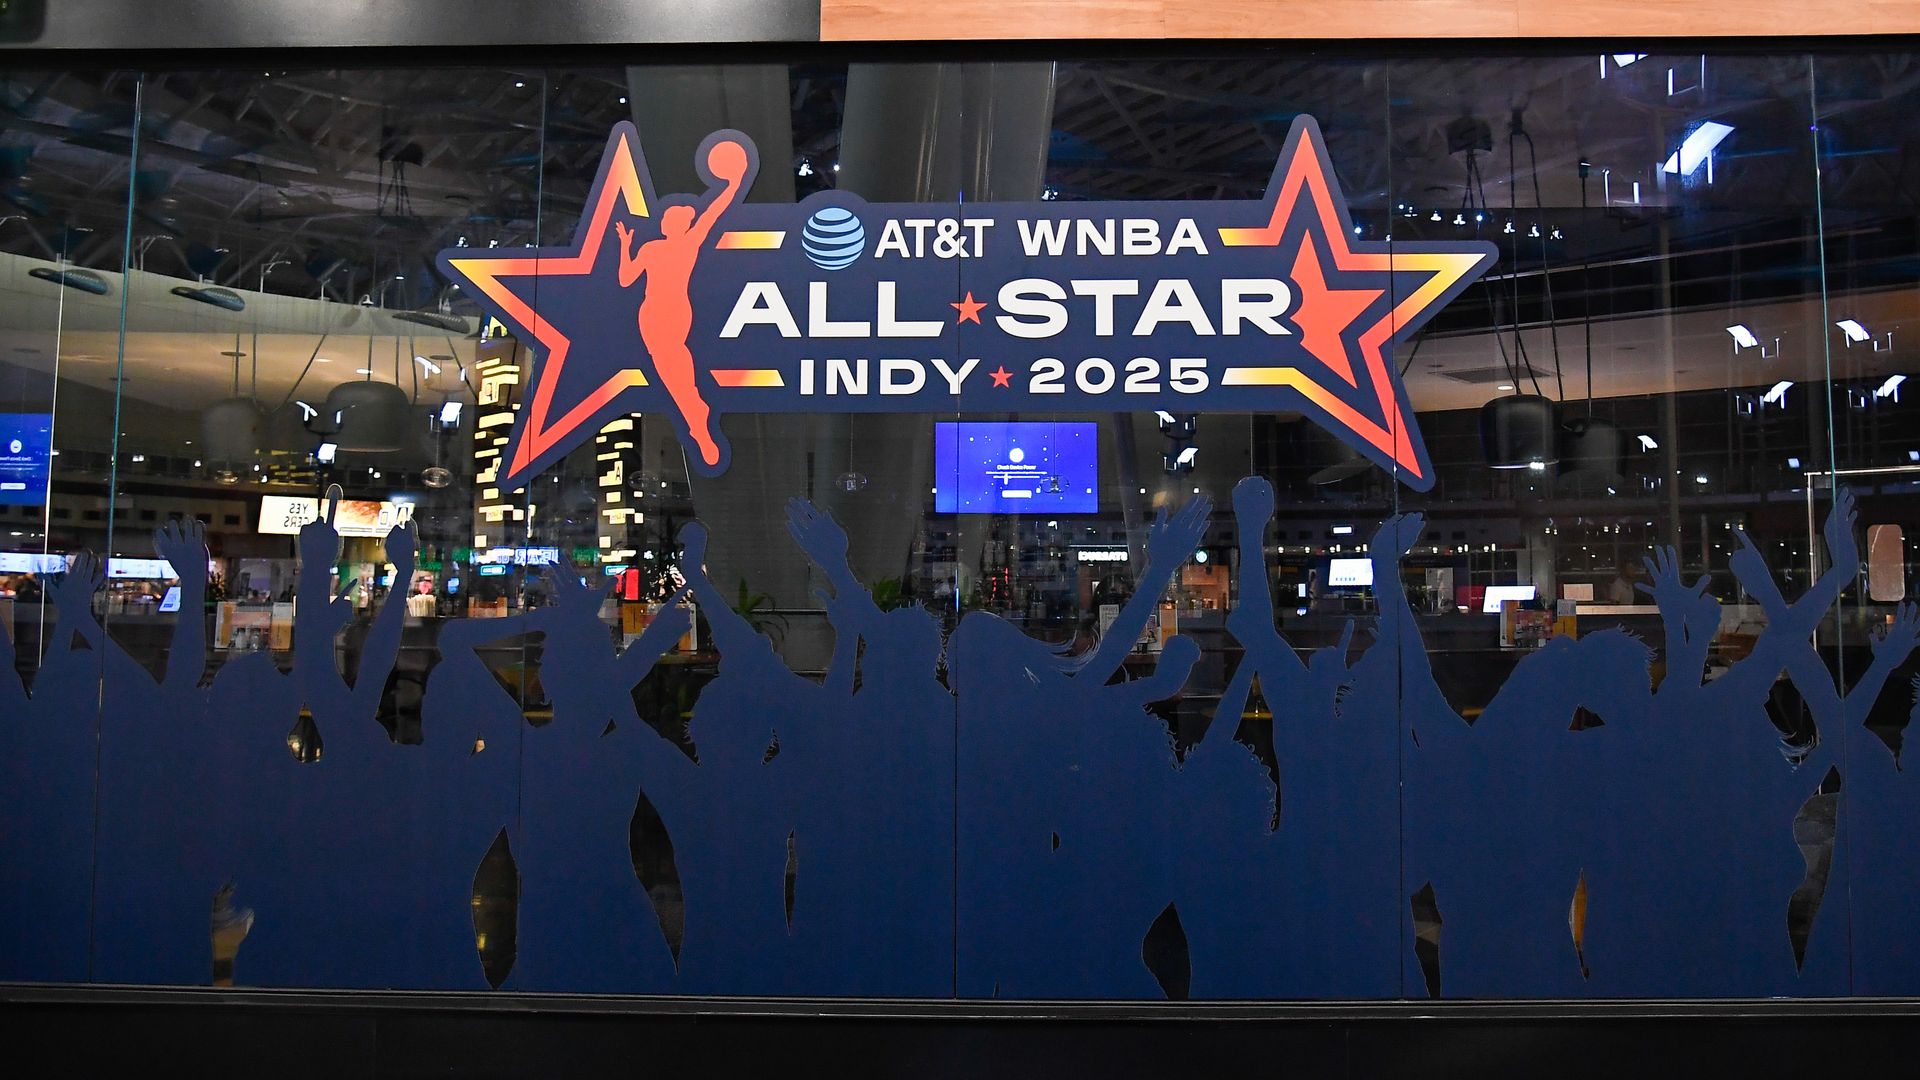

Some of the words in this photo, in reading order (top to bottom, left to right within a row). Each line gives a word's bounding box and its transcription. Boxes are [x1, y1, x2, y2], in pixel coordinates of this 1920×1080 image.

[874, 218, 995, 259] AT&T
[1016, 218, 1209, 256] WNBA
[718, 281, 945, 338] ALL
[995, 278, 1293, 339] STAR
[800, 358, 981, 395] INDY
[1029, 357, 1210, 394] 2025
